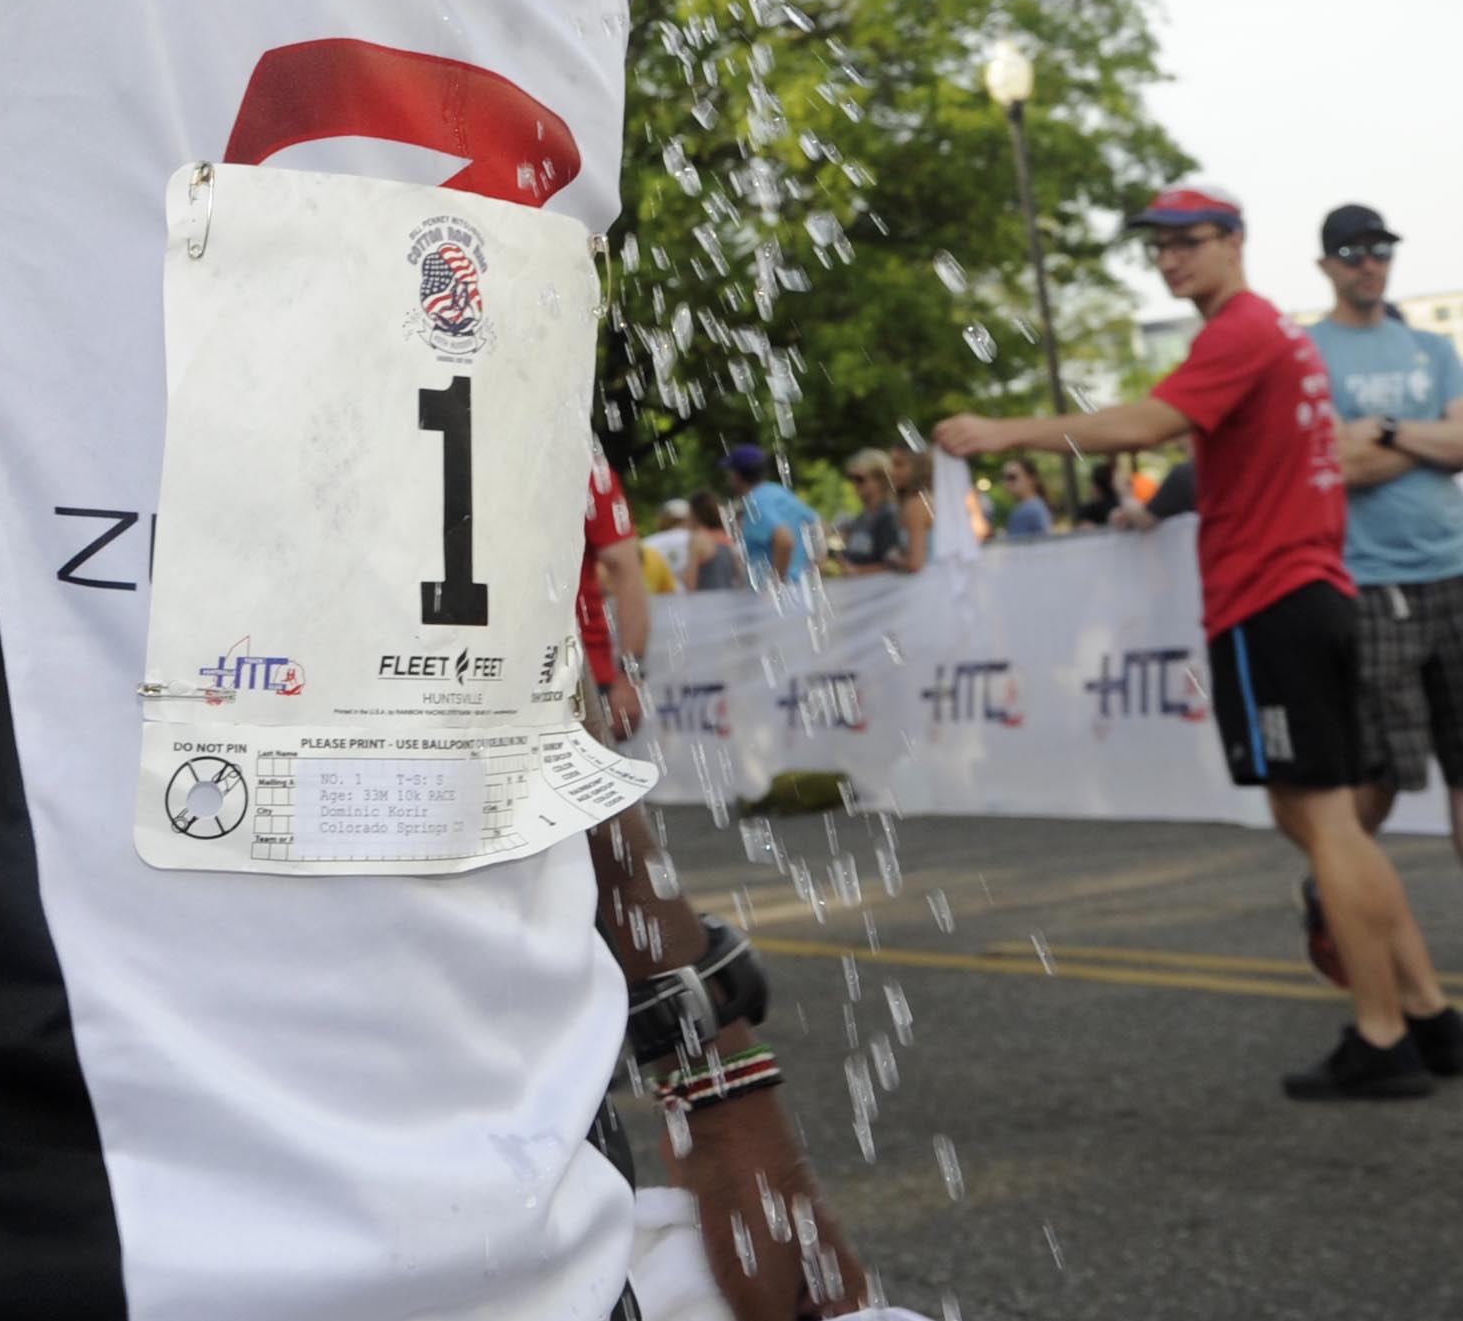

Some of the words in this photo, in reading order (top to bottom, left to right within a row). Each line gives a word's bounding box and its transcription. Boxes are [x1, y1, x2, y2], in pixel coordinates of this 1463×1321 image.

[407, 227, 443, 266] COTTON
[419, 376, 488, 626] 1
[378, 656, 450, 676] FLEET
[473, 657, 505, 677] FEET
[423, 692, 483, 705] HUNTSVILLE
[174, 742, 192, 752] DO
[196, 743, 223, 753] NOT
[226, 743, 248, 753] PIN
[301, 738, 346, 749] PLEASE
[349, 739, 386, 749] PRINT
[396, 740, 419, 749] USE
[422, 739, 474, 750] BALLPOINT
[258, 778, 287, 787] Mailing
[320, 774, 344, 785] NO.
[320, 790, 353, 802] Age:
[256, 808, 272, 816] City
[320, 806, 379, 817] Dominic
[389, 807, 429, 818] Korir
[320, 822, 388, 833] Colorado
[396, 822, 448, 836] Springs
